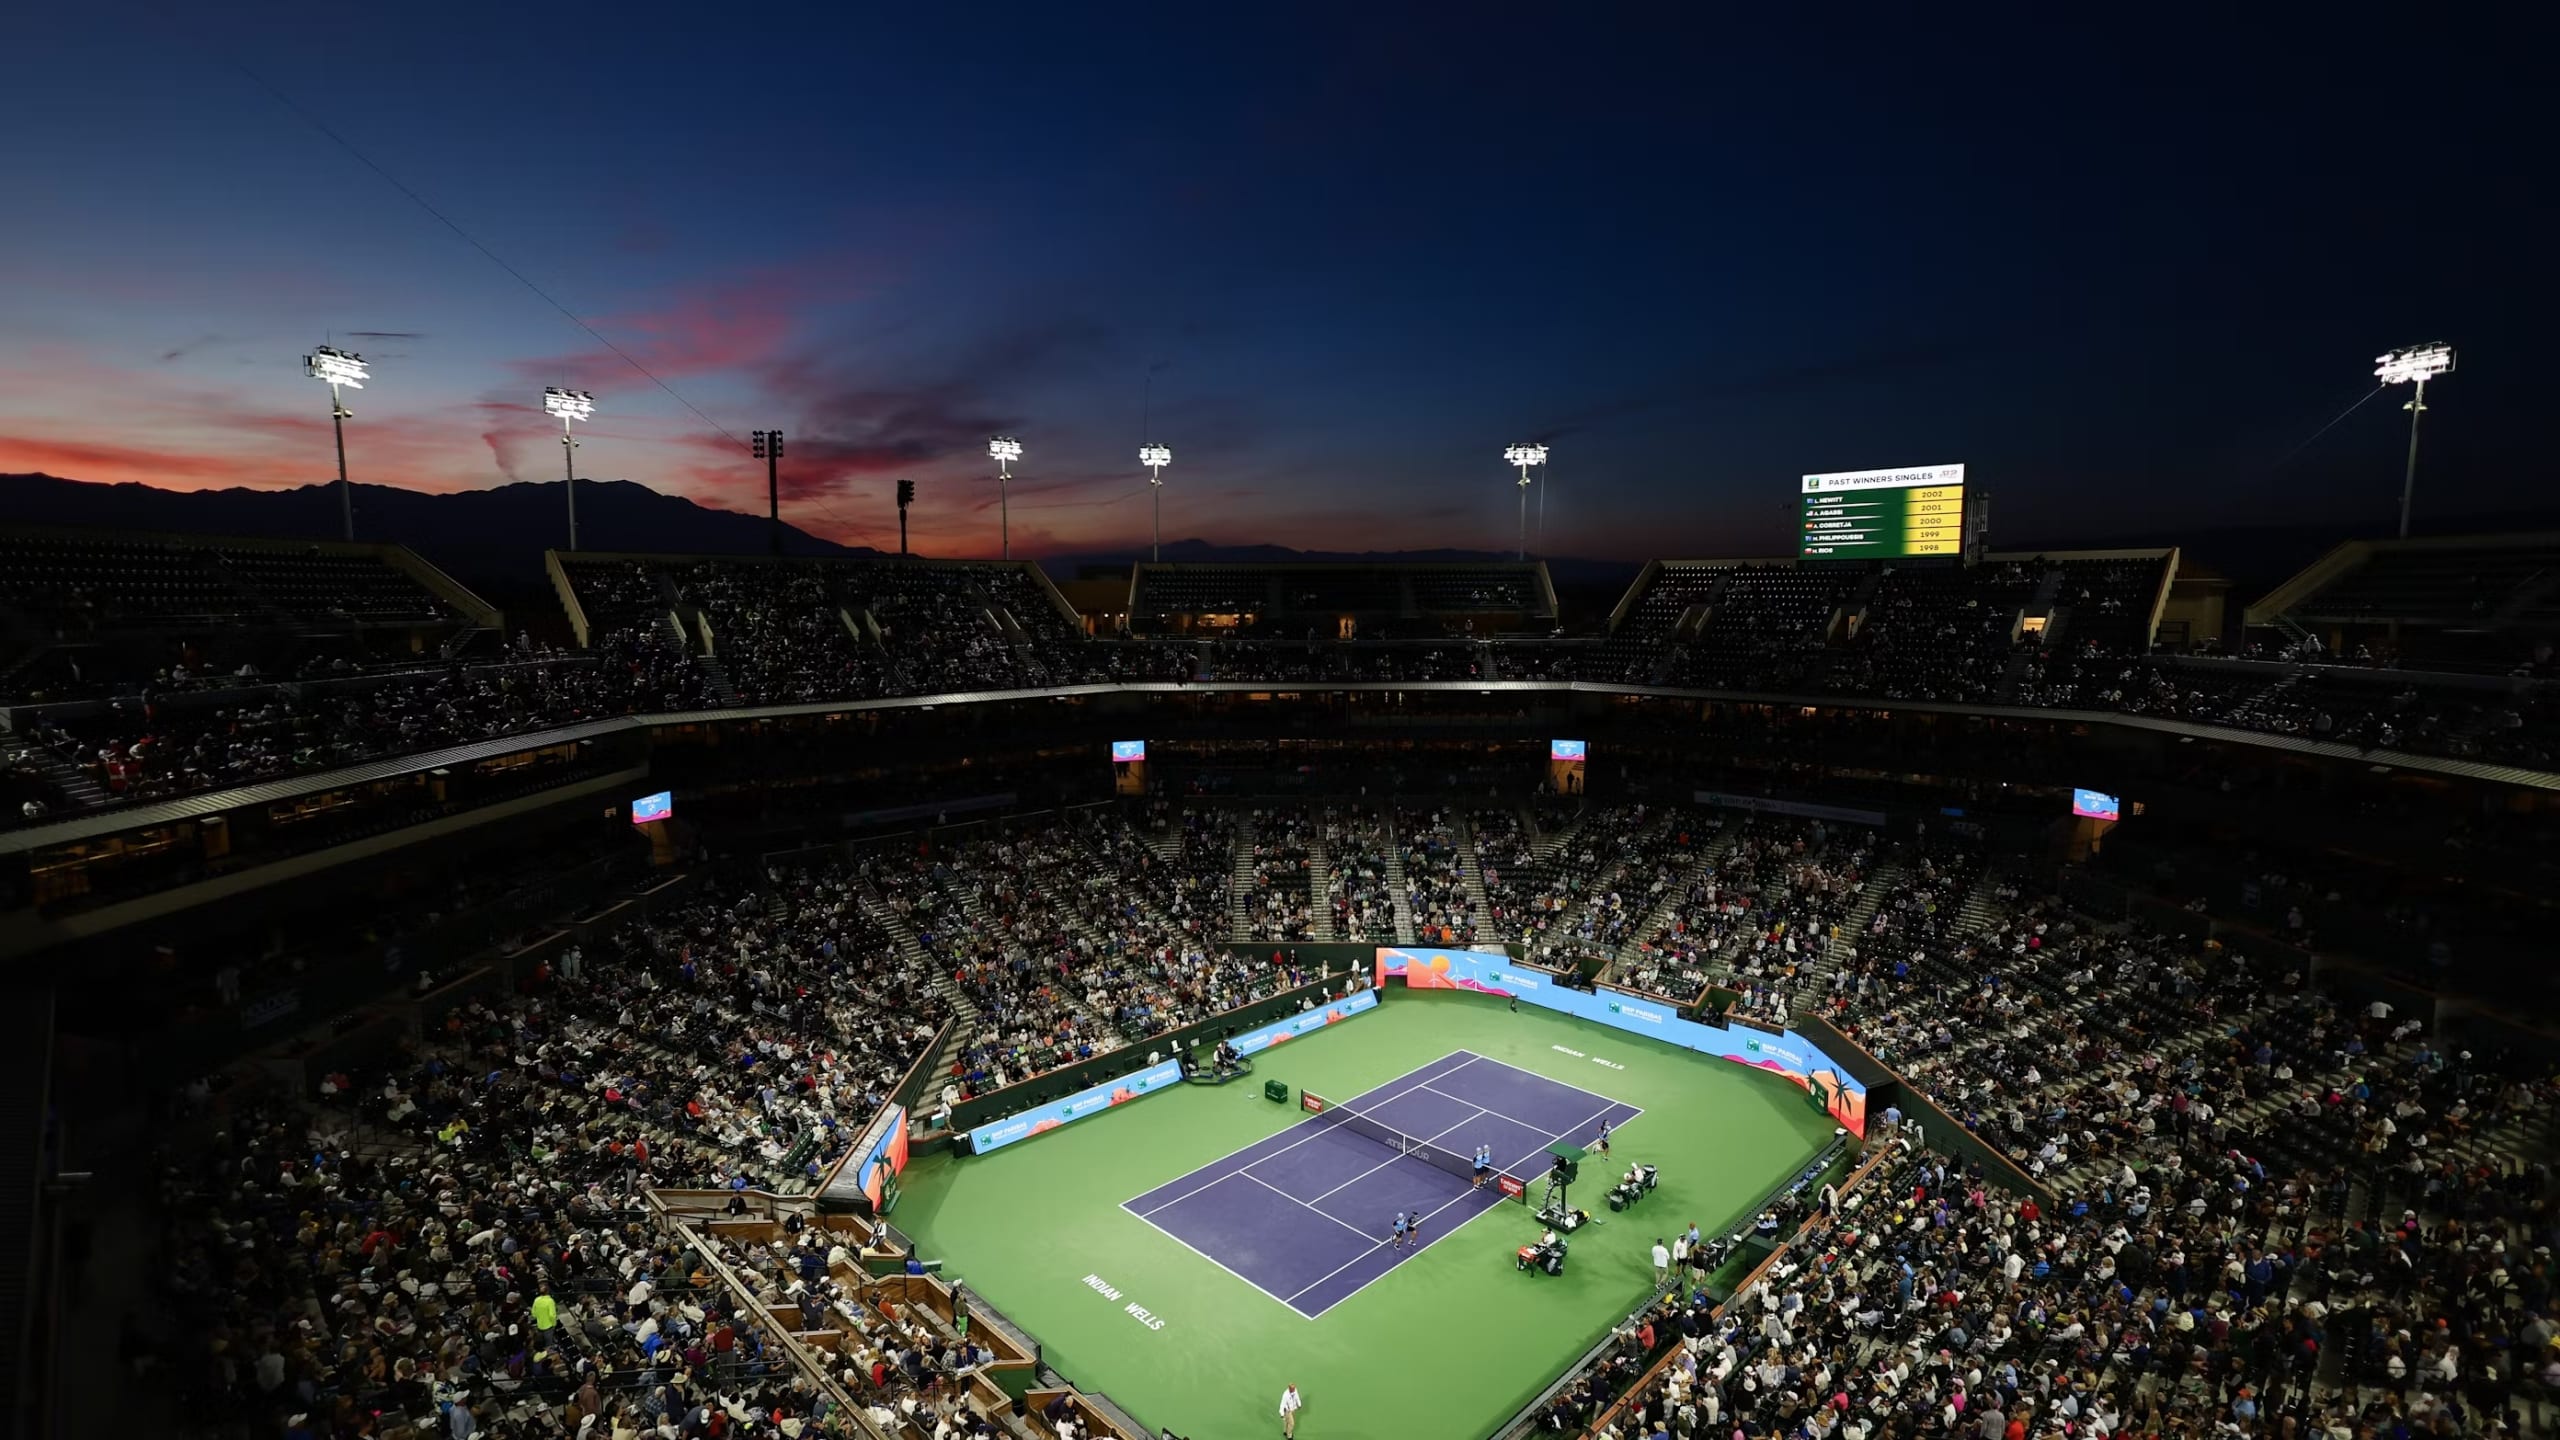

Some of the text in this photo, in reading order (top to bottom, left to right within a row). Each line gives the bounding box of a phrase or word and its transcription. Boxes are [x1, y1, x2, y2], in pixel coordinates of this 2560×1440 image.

[1829, 478, 1850, 486] PAST
[1853, 475, 1893, 484] WINNERS
[1895, 472, 1933, 482] SINGLES
[1635, 1008, 1662, 1021] PARIBAS
[1552, 1044, 1625, 1070] INDIAN WELLS
[1762, 1043, 1777, 1053] BNP
[1778, 1048, 1802, 1063] PARIBAS
[1385, 1138, 1430, 1162] ATP TOUR
[1081, 1273, 1165, 1330] INDIAN WELLS
